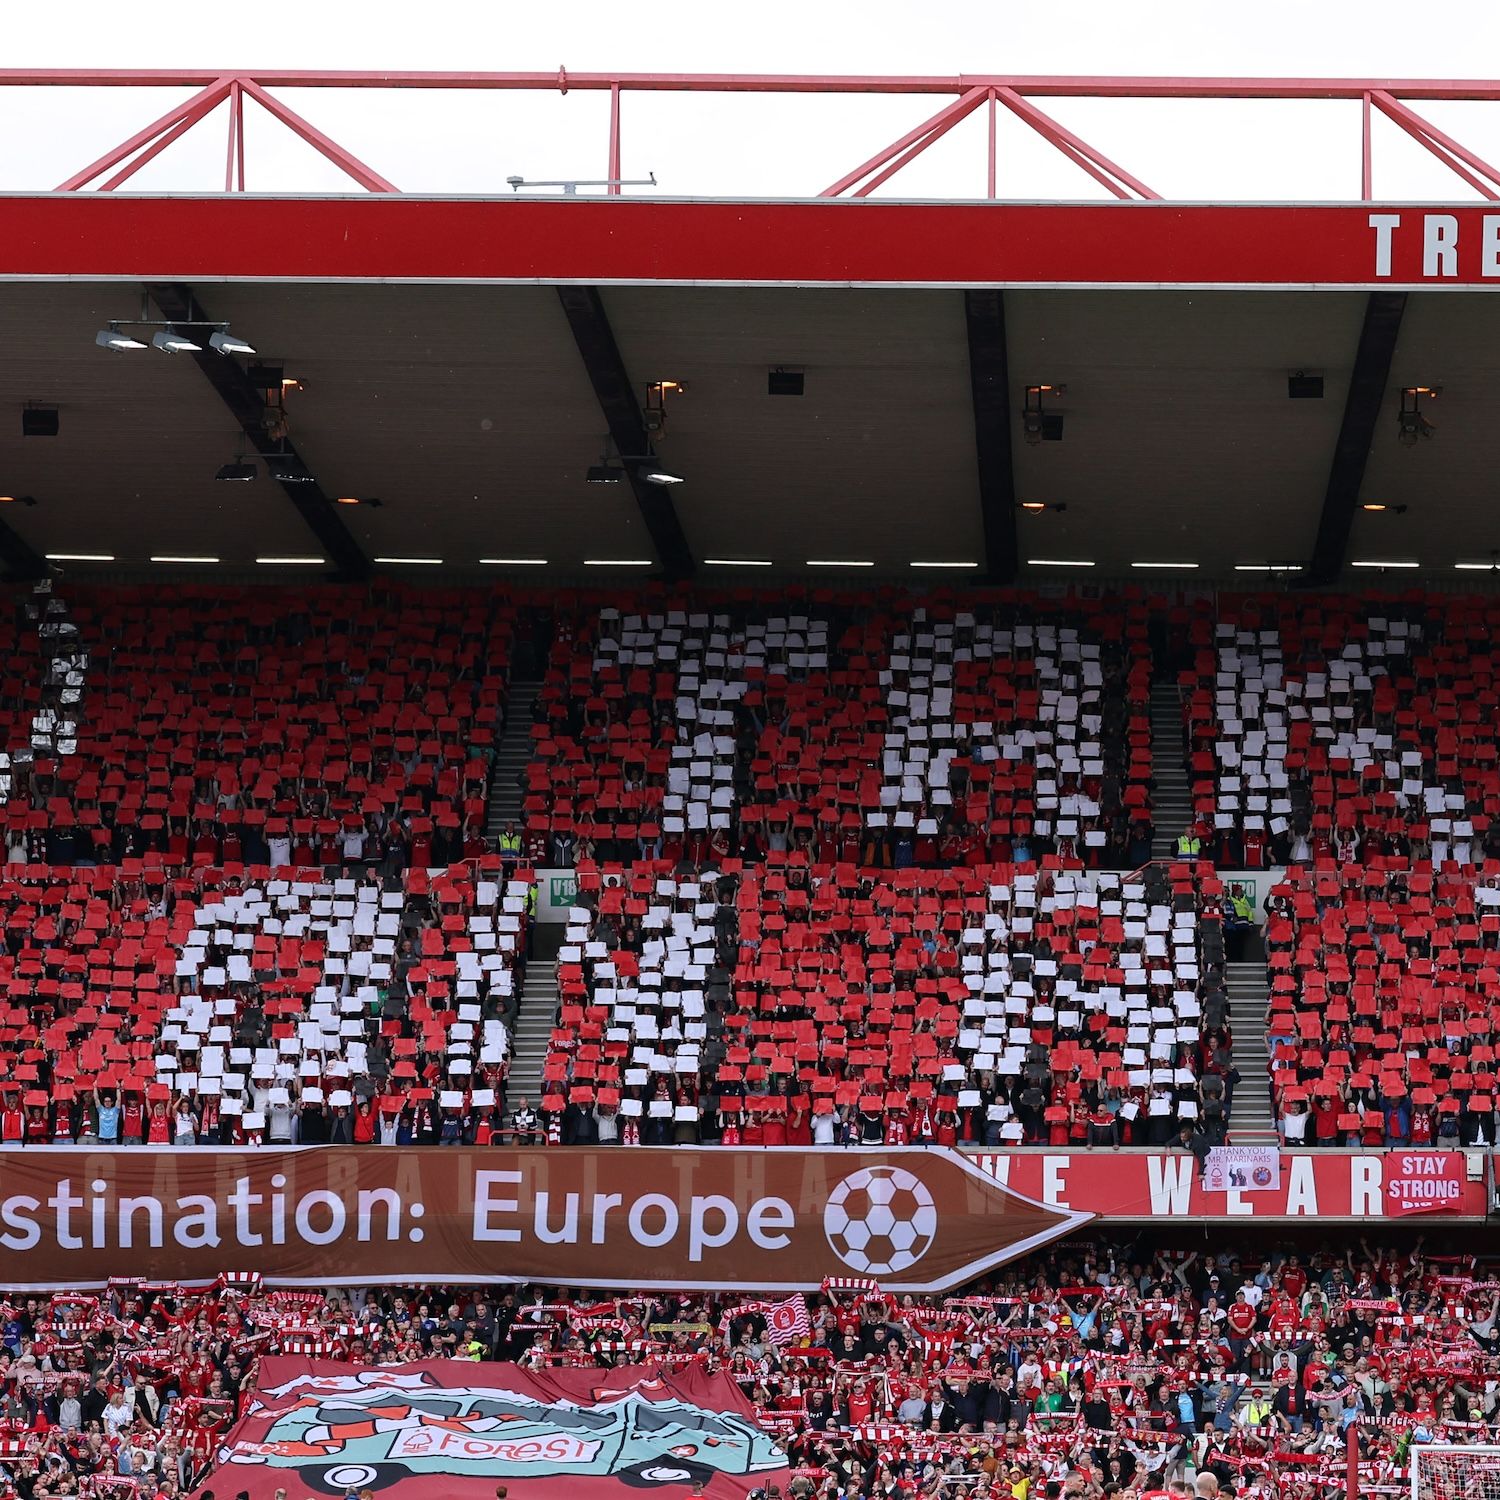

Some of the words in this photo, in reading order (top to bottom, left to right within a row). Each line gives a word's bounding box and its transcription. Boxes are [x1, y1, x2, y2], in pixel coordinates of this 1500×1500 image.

[1214, 1147, 1242, 1155] THANK
[1247, 1147, 1267, 1155] YOU
[1225, 1155, 1272, 1163] MARINAKIS
[1402, 1156, 1447, 1175] STAY
[1389, 1180, 1460, 1198] STRONG
[0, 1172, 425, 1252] stination:
[473, 1169, 795, 1263] Europe
[723, 1302, 760, 1318] NFFC
[582, 1318, 620, 1328] NFFC
[1035, 1433, 1076, 1443] NFFC
[1018, 1452, 1057, 1462] NFFC
[1294, 1472, 1340, 1487] NFFC
